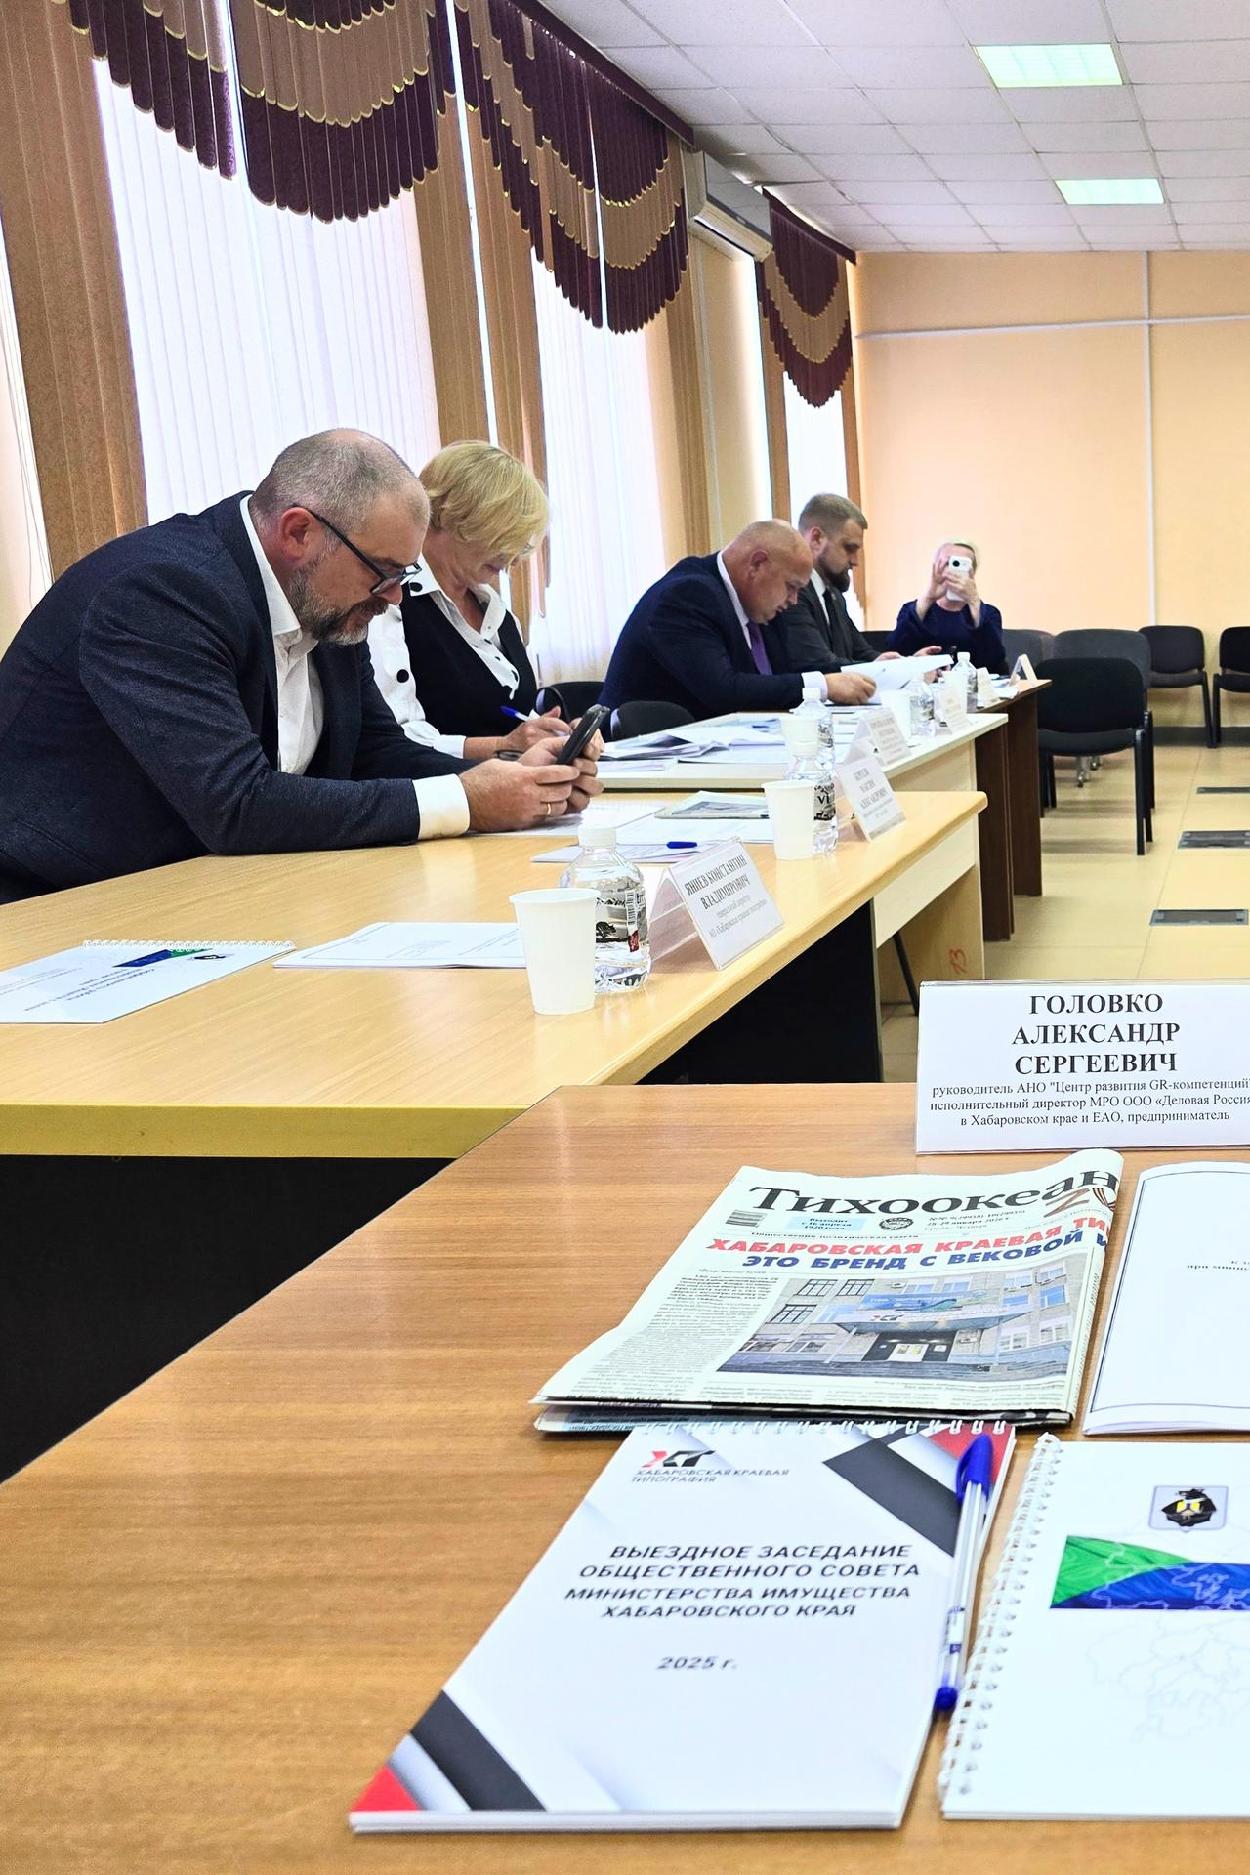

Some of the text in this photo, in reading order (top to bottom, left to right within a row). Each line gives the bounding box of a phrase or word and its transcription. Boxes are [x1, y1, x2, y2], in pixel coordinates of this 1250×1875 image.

[1029, 993, 1163, 1015] ГОЛОВКО
[1012, 1022, 1180, 1046] АЛЕКСАНДР
[1015, 1052, 1178, 1075] СЕРГЕЕВИЧ
[933, 1083, 1013, 1098] руководитель
[1017, 1082, 1046, 1094] АНО
[1051, 1081, 1091, 1094] "Центр
[1094, 1081, 1146, 1095] развития
[930, 1098, 1029, 1112] исполнительный
[1032, 1098, 1087, 1111] директор
[1090, 1096, 1120, 1107] МРО
[1123, 1095, 1151, 1106] ООО
[1155, 1094, 1210, 1108] «Деловая
[961, 1111, 1230, 1129] в Хабаровском крае и ЕАО, предприниматель
[706, 1238, 924, 1256] ХАБАРОВСКАЯ
[936, 1225, 1063, 1252] КРАЕВАЯ
[742, 1256, 800, 1268] ЭТО
[811, 1257, 907, 1270] БРЕНД
[920, 1255, 937, 1267] С
[947, 1229, 1084, 1265] ВЕКОВОЙ
[609, 1545, 913, 1560] ВЫЕЗДНОЕ ЗАСЕДАНИЕ
[579, 1564, 920, 1580] ОБЩЕСТВЕННОГО СОВЕТА
[564, 1587, 911, 1601] МИНИСТЕРСТВА ИМУЩЕСТВА
[601, 1605, 856, 1617] ХАБАРОВСКОГО КРАЯ
[657, 1656, 716, 1670] 2025
